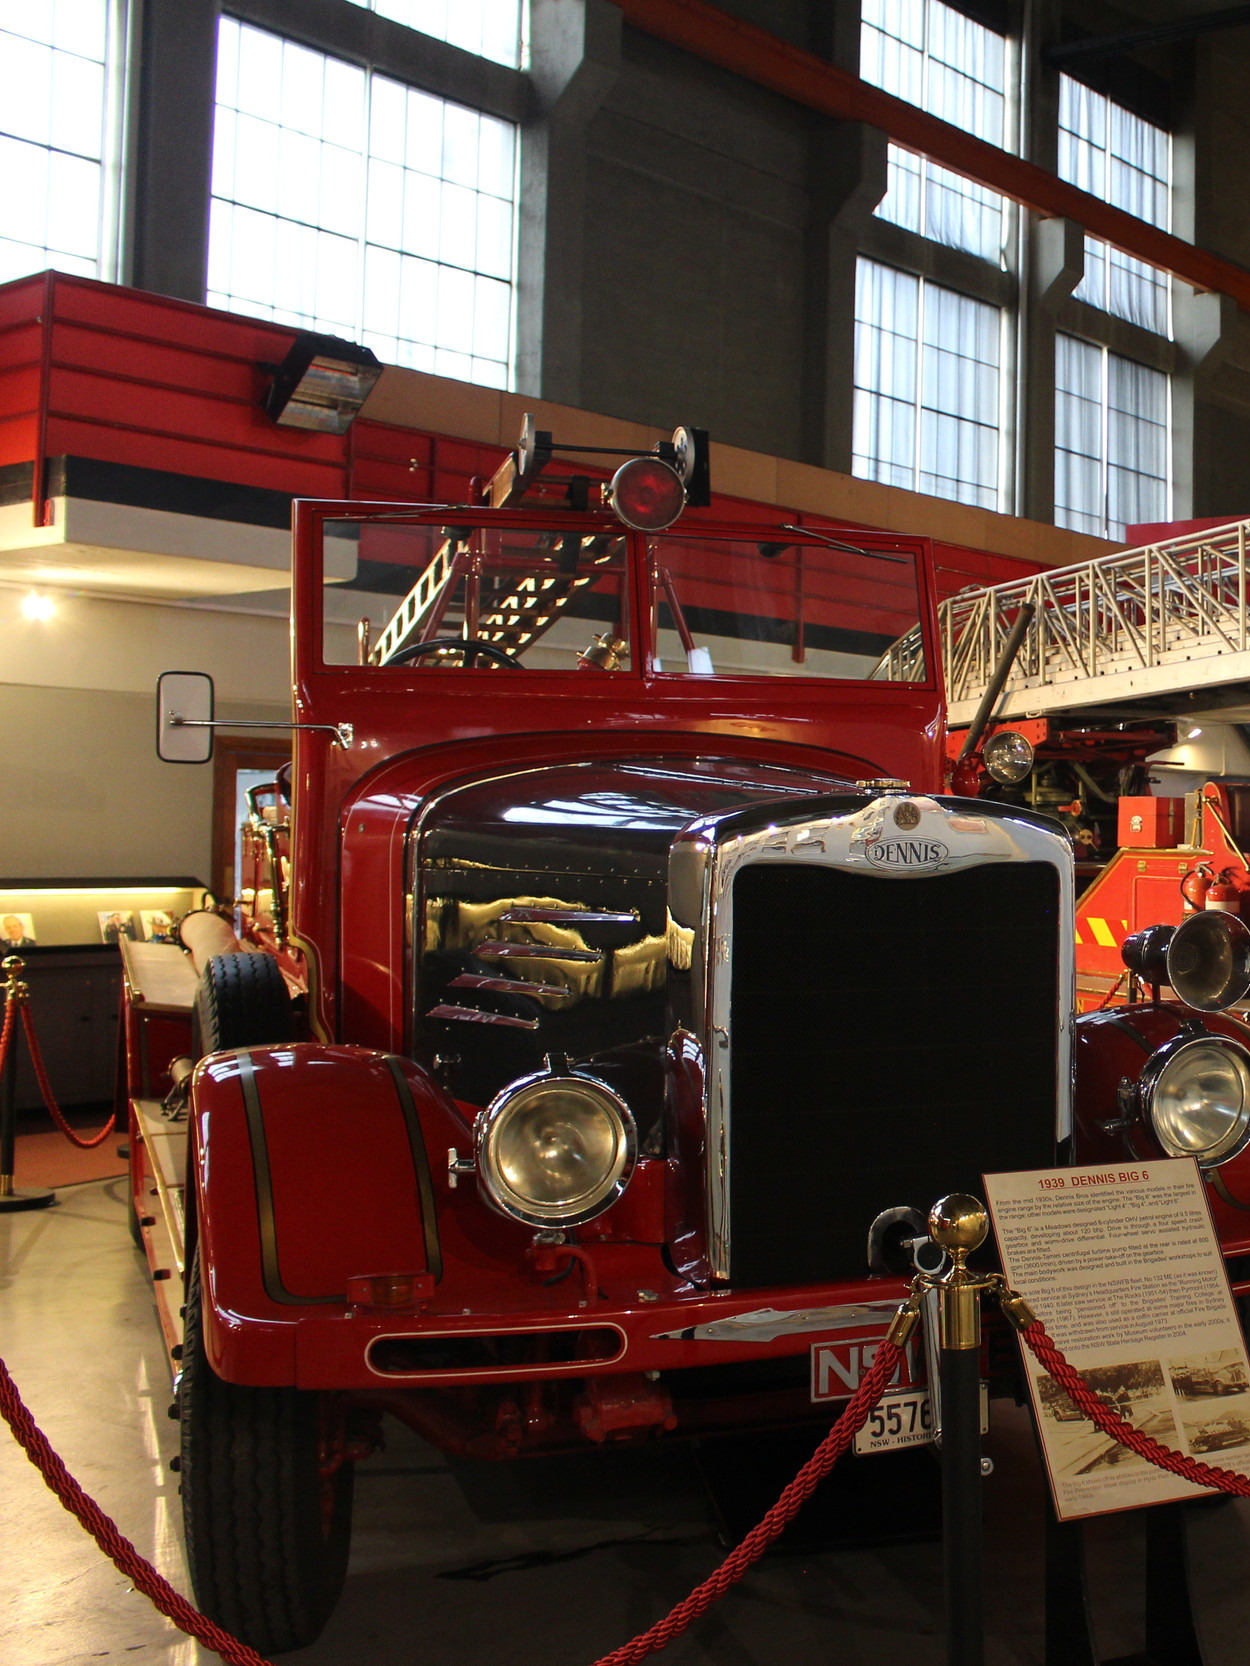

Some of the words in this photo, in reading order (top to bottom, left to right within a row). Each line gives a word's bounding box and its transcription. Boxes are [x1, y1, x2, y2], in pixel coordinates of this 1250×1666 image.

[874, 842, 942, 865] DENNIS
[1038, 1178, 1065, 1189] 1939
[1071, 1174, 1116, 1186] DENNIS
[1118, 1172, 1140, 1182] BIG
[1141, 1171, 1149, 1180] 6
[870, 1438, 890, 1448] NSW
